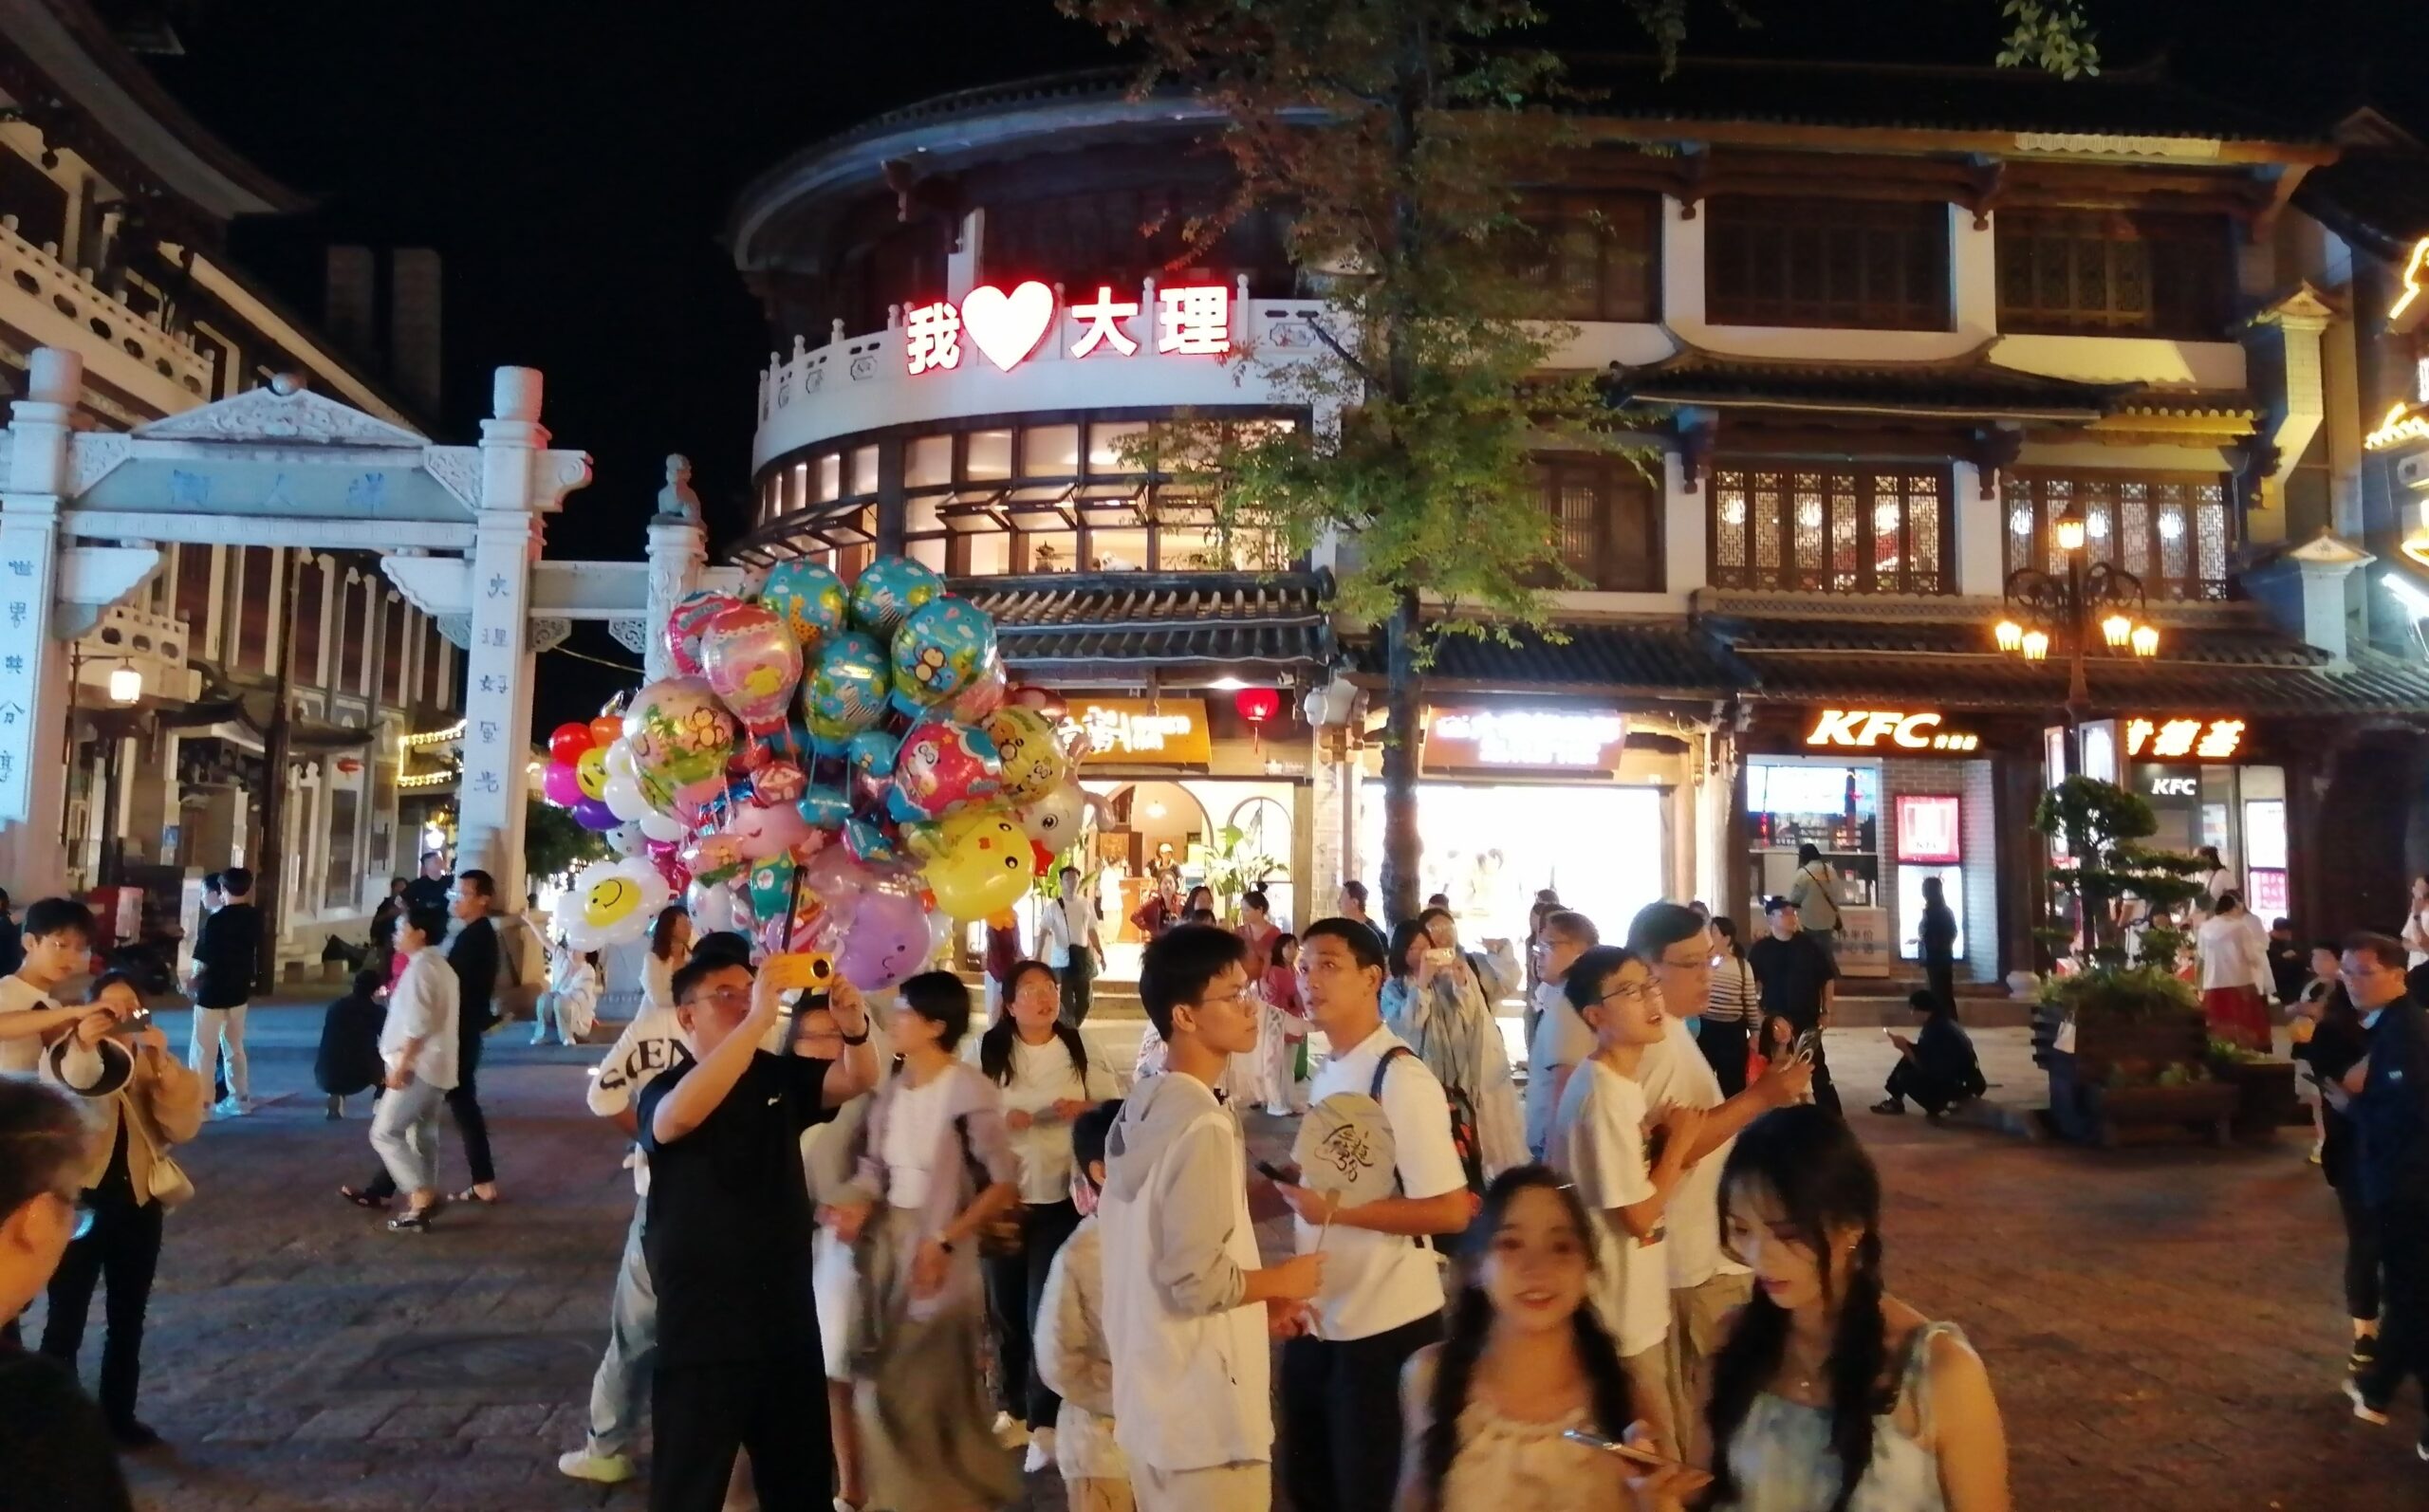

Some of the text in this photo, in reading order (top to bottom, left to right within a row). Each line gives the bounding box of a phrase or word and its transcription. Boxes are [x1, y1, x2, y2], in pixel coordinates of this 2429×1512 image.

[906, 286, 1231, 376] 我 大理
[1806, 710, 1941, 747] KFC
[2150, 778, 2197, 795] KFC
